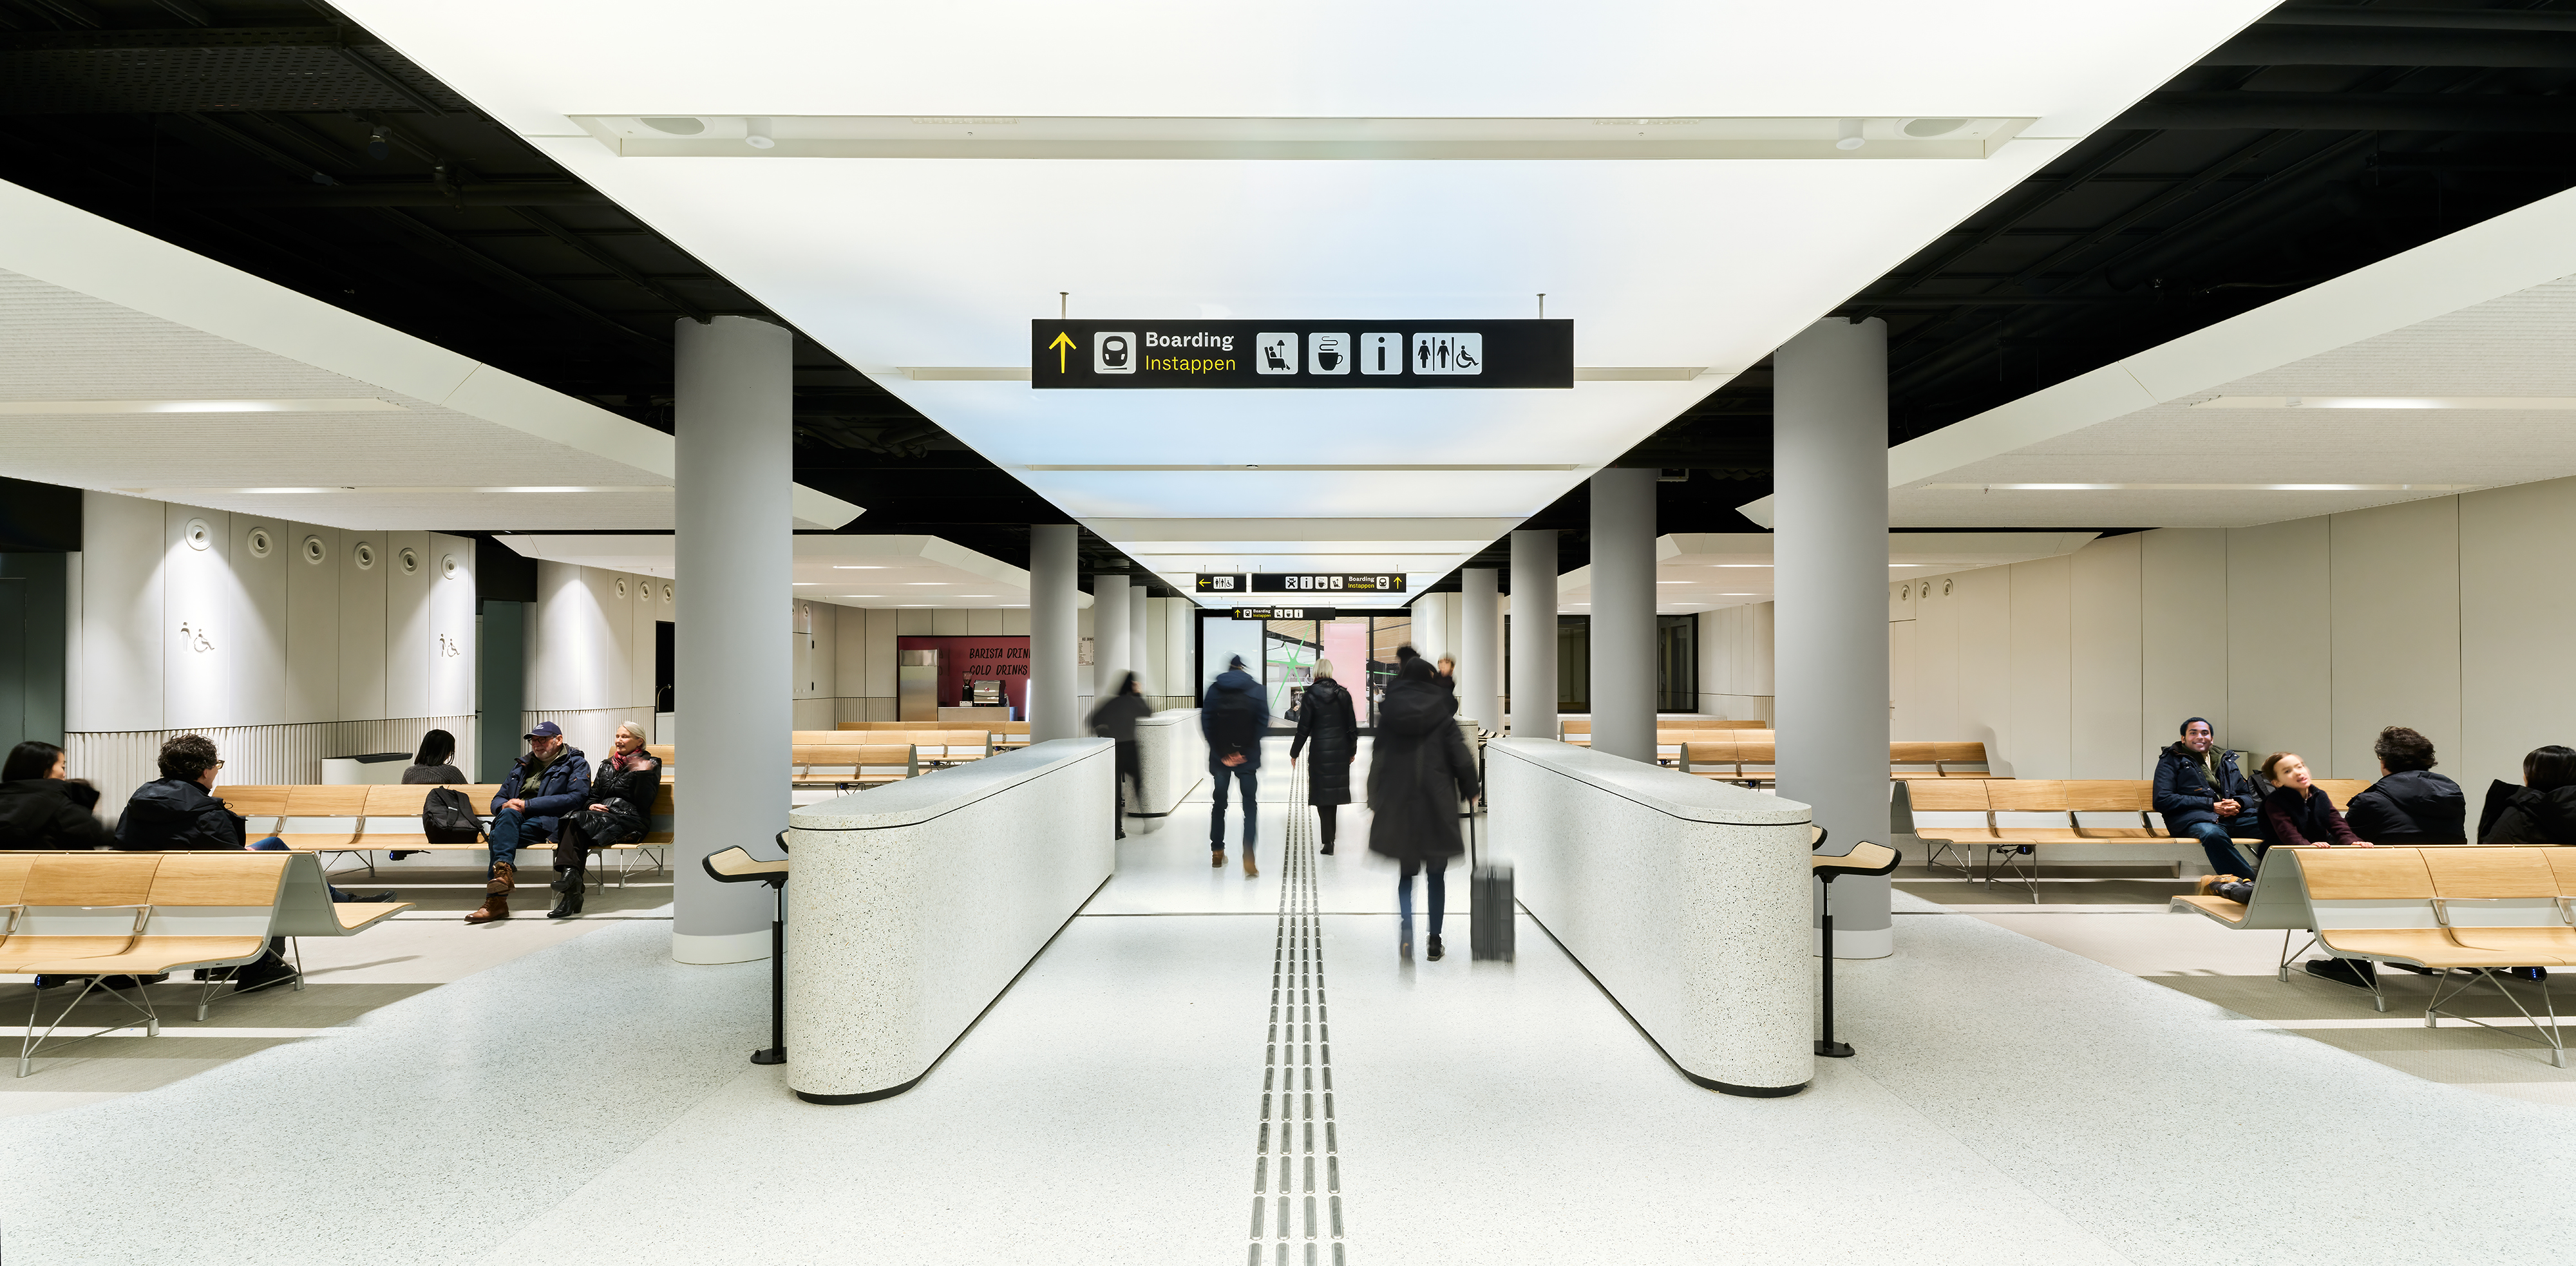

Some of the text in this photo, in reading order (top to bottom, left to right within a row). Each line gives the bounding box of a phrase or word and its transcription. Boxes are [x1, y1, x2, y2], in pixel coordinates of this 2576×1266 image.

[1146, 332, 1235, 351] Boarding
[1146, 355, 1235, 373] Instappen
[969, 648, 1030, 659] BARISTA DRIN
[996, 665, 1028, 676] DRINKS
